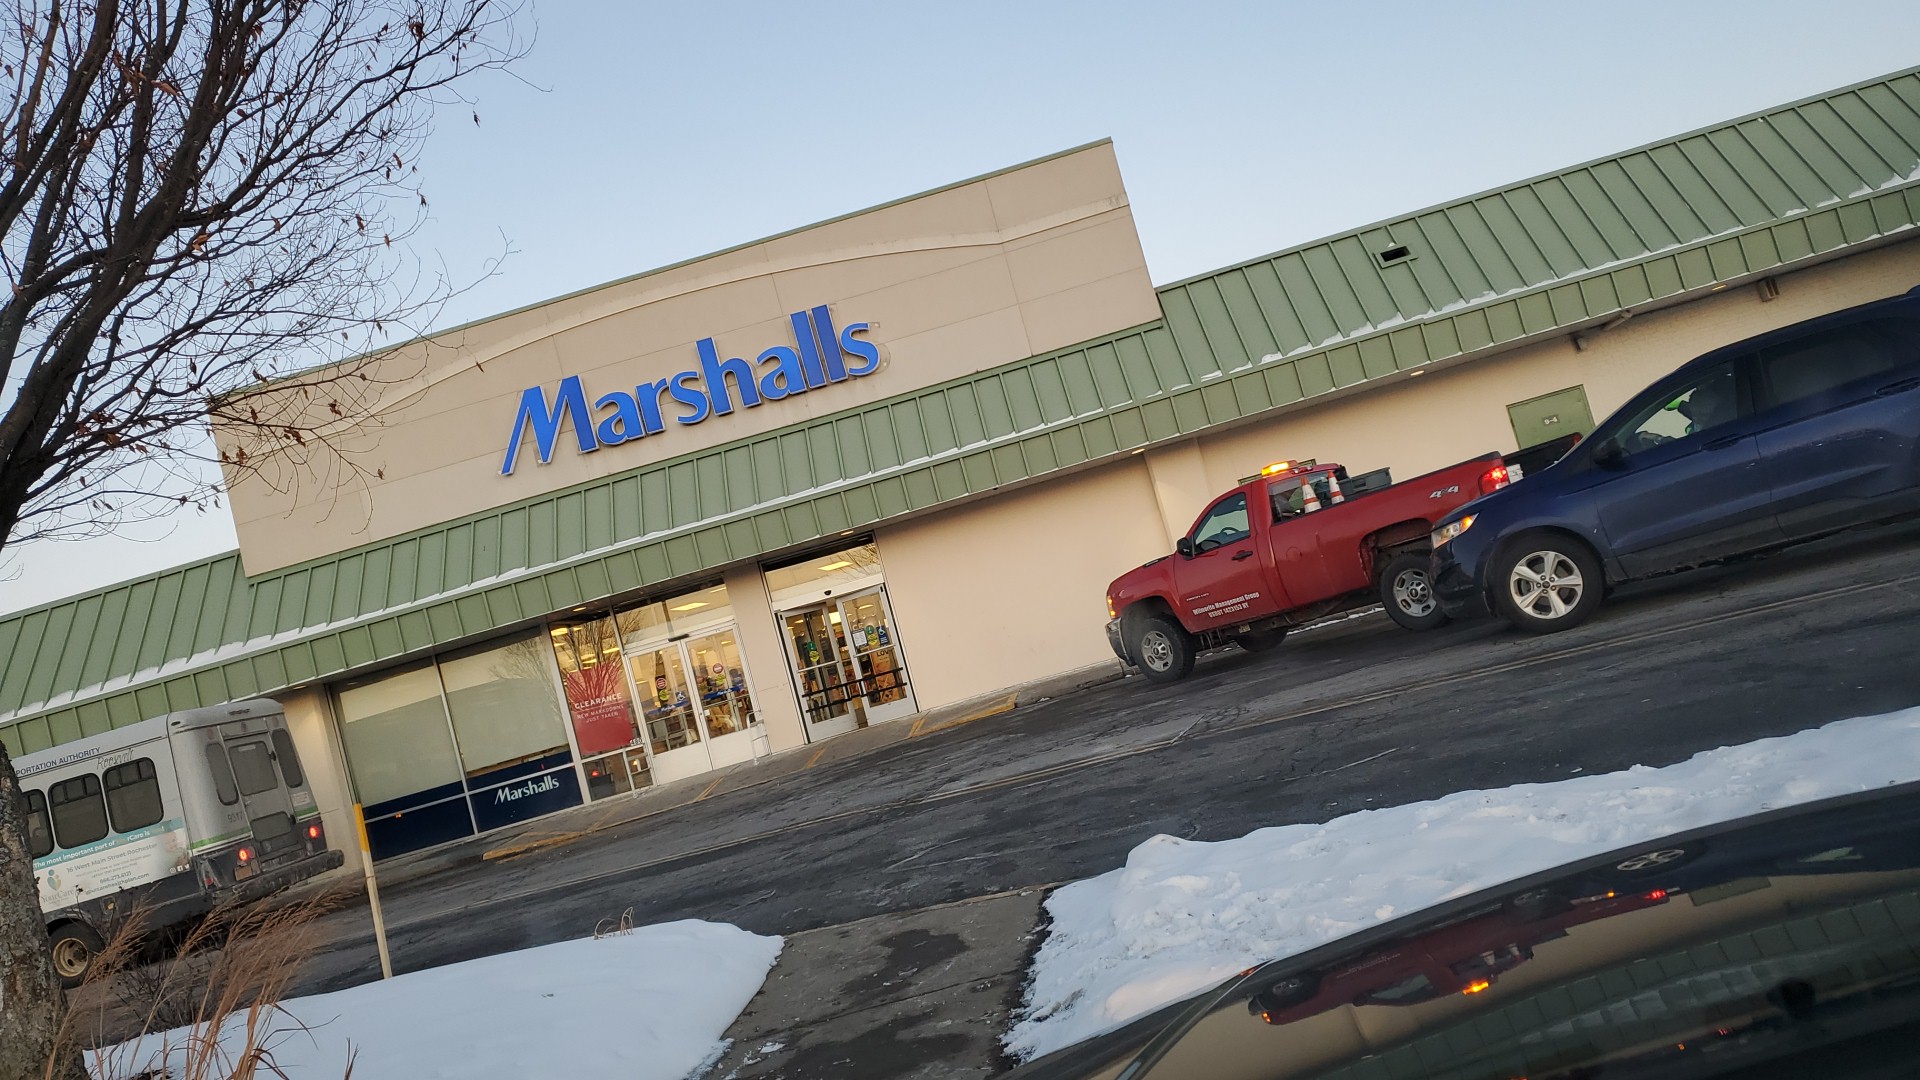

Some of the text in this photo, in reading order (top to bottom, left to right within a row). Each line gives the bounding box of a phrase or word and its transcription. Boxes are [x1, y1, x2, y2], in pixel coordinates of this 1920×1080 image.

[500, 304, 881, 476] Marshalls
[1215, 596, 1245, 609] Management
[1244, 592, 1260, 602] Group
[574, 692, 623, 710] CLEARANCE
[576, 704, 625, 720] NEW MARKDOWNS
[58, 746, 101, 765] AUTHORITY
[494, 775, 560, 805] Marshalls
[33, 860, 46, 869] The
[46, 856, 62, 867] most
[63, 846, 94, 860] important
[94, 843, 108, 855] part
[108, 840, 116, 848] of
[91, 856, 107, 869] Main
[107, 851, 127, 864] Street
